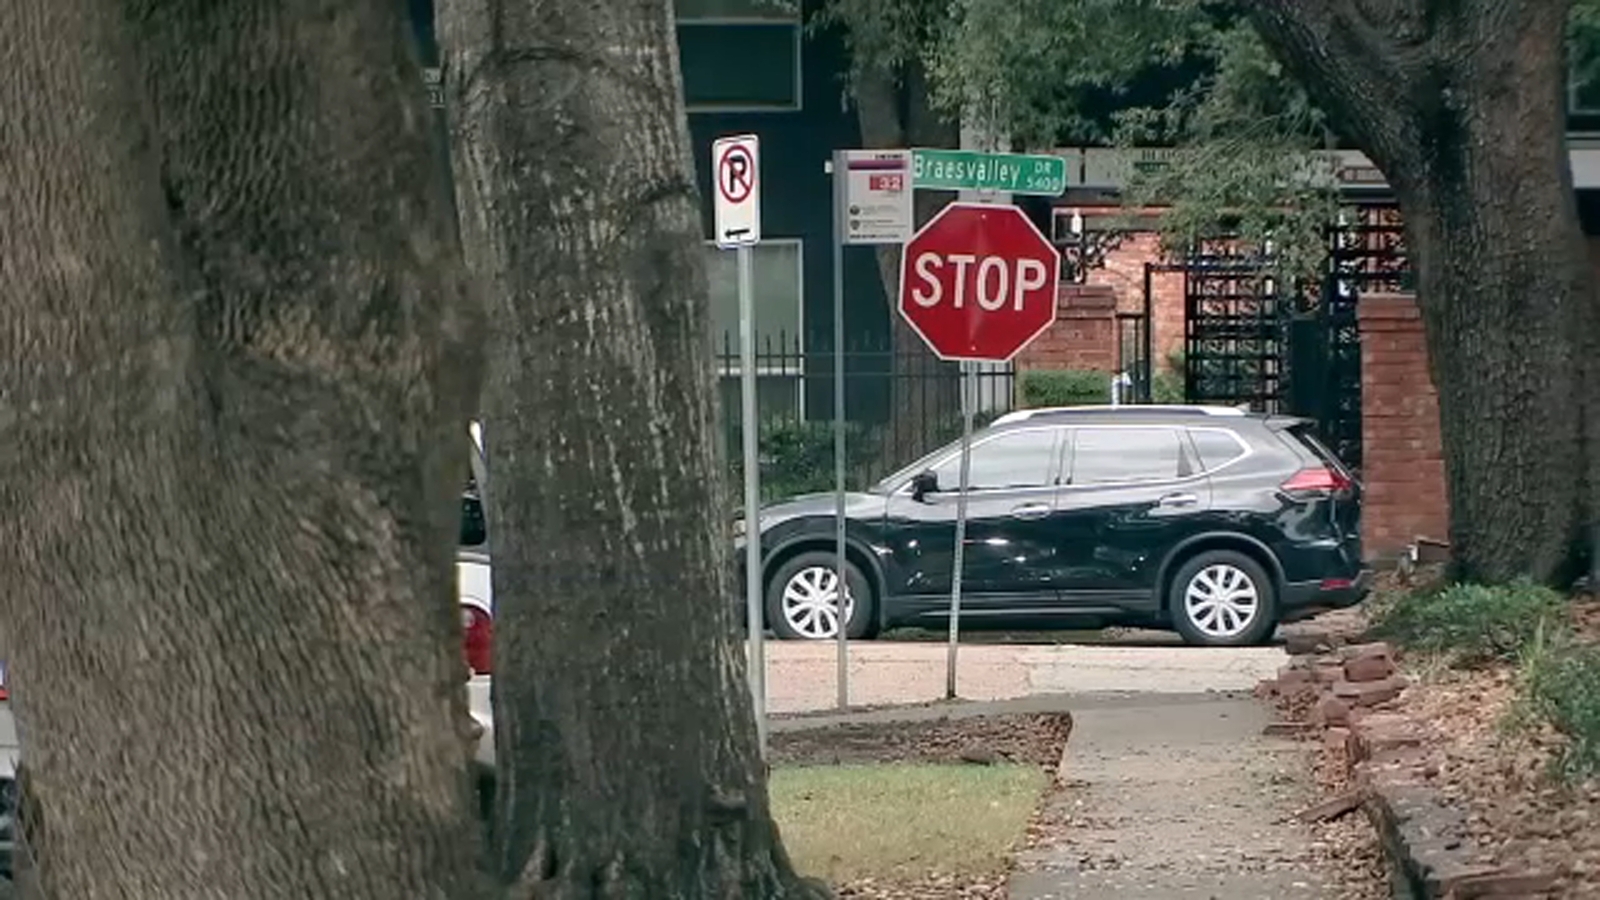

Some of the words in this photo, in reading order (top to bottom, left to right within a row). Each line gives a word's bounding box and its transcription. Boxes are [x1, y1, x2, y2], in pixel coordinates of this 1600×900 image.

[729, 155, 747, 193] P
[914, 155, 1020, 187] Braesvalley
[912, 252, 1046, 311] STOP
